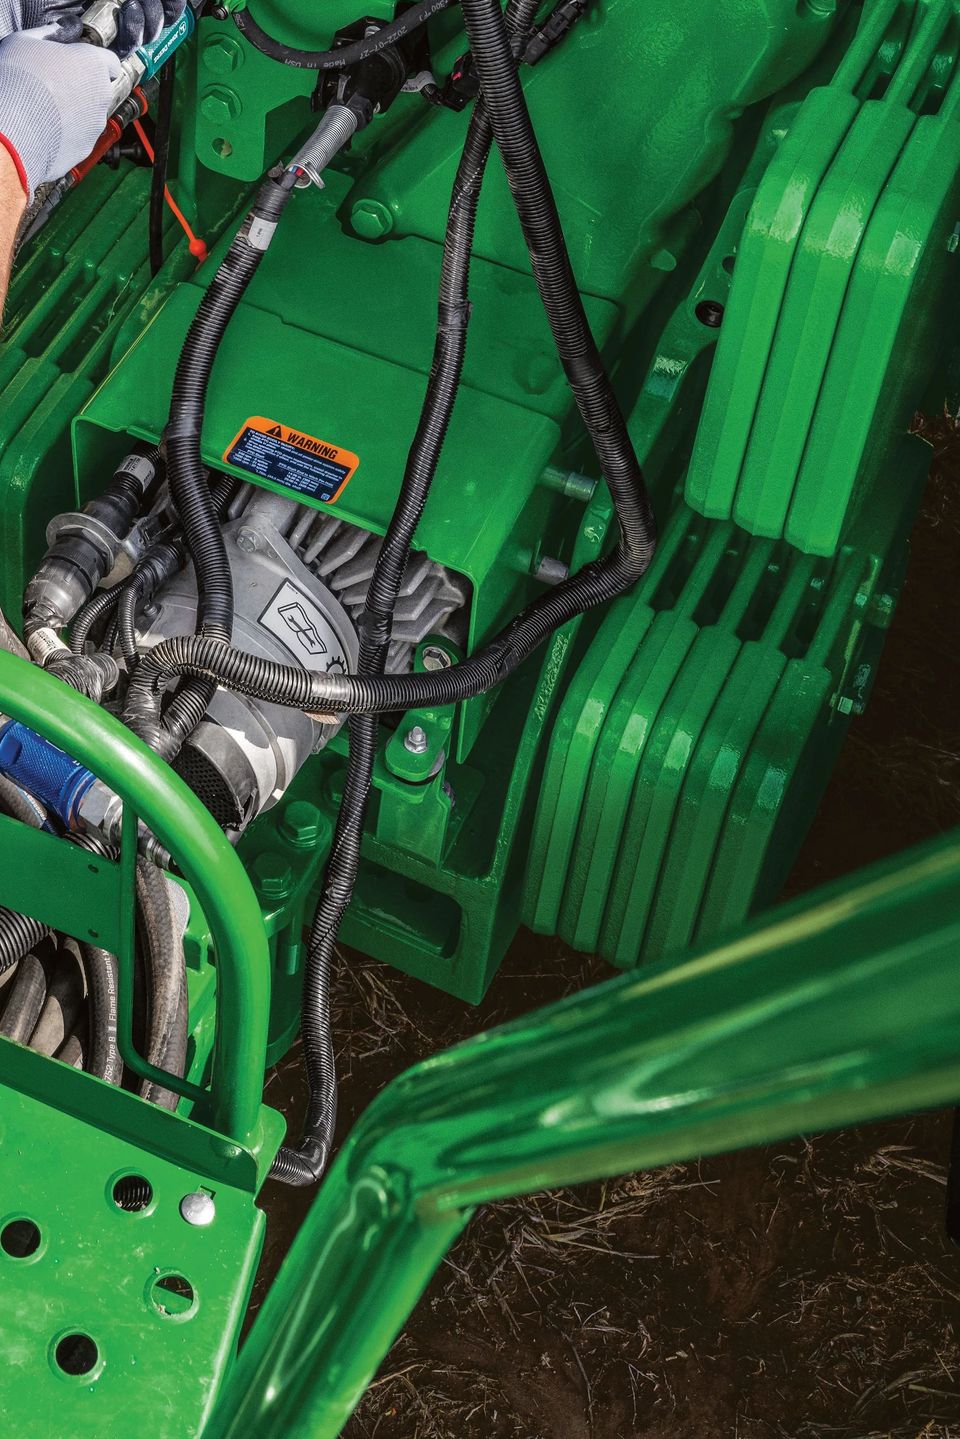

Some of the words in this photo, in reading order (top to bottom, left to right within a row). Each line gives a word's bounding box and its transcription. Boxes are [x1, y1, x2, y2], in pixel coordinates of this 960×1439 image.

[360, 25, 408, 60] 2022-07-27
[284, 58, 302, 68] USA
[323, 58, 346, 68] Made
[287, 432, 339, 460] WARNING
[104, 956, 116, 995] Resistant
[108, 995, 116, 1022] Flame
[106, 1044, 116, 1063] Type
